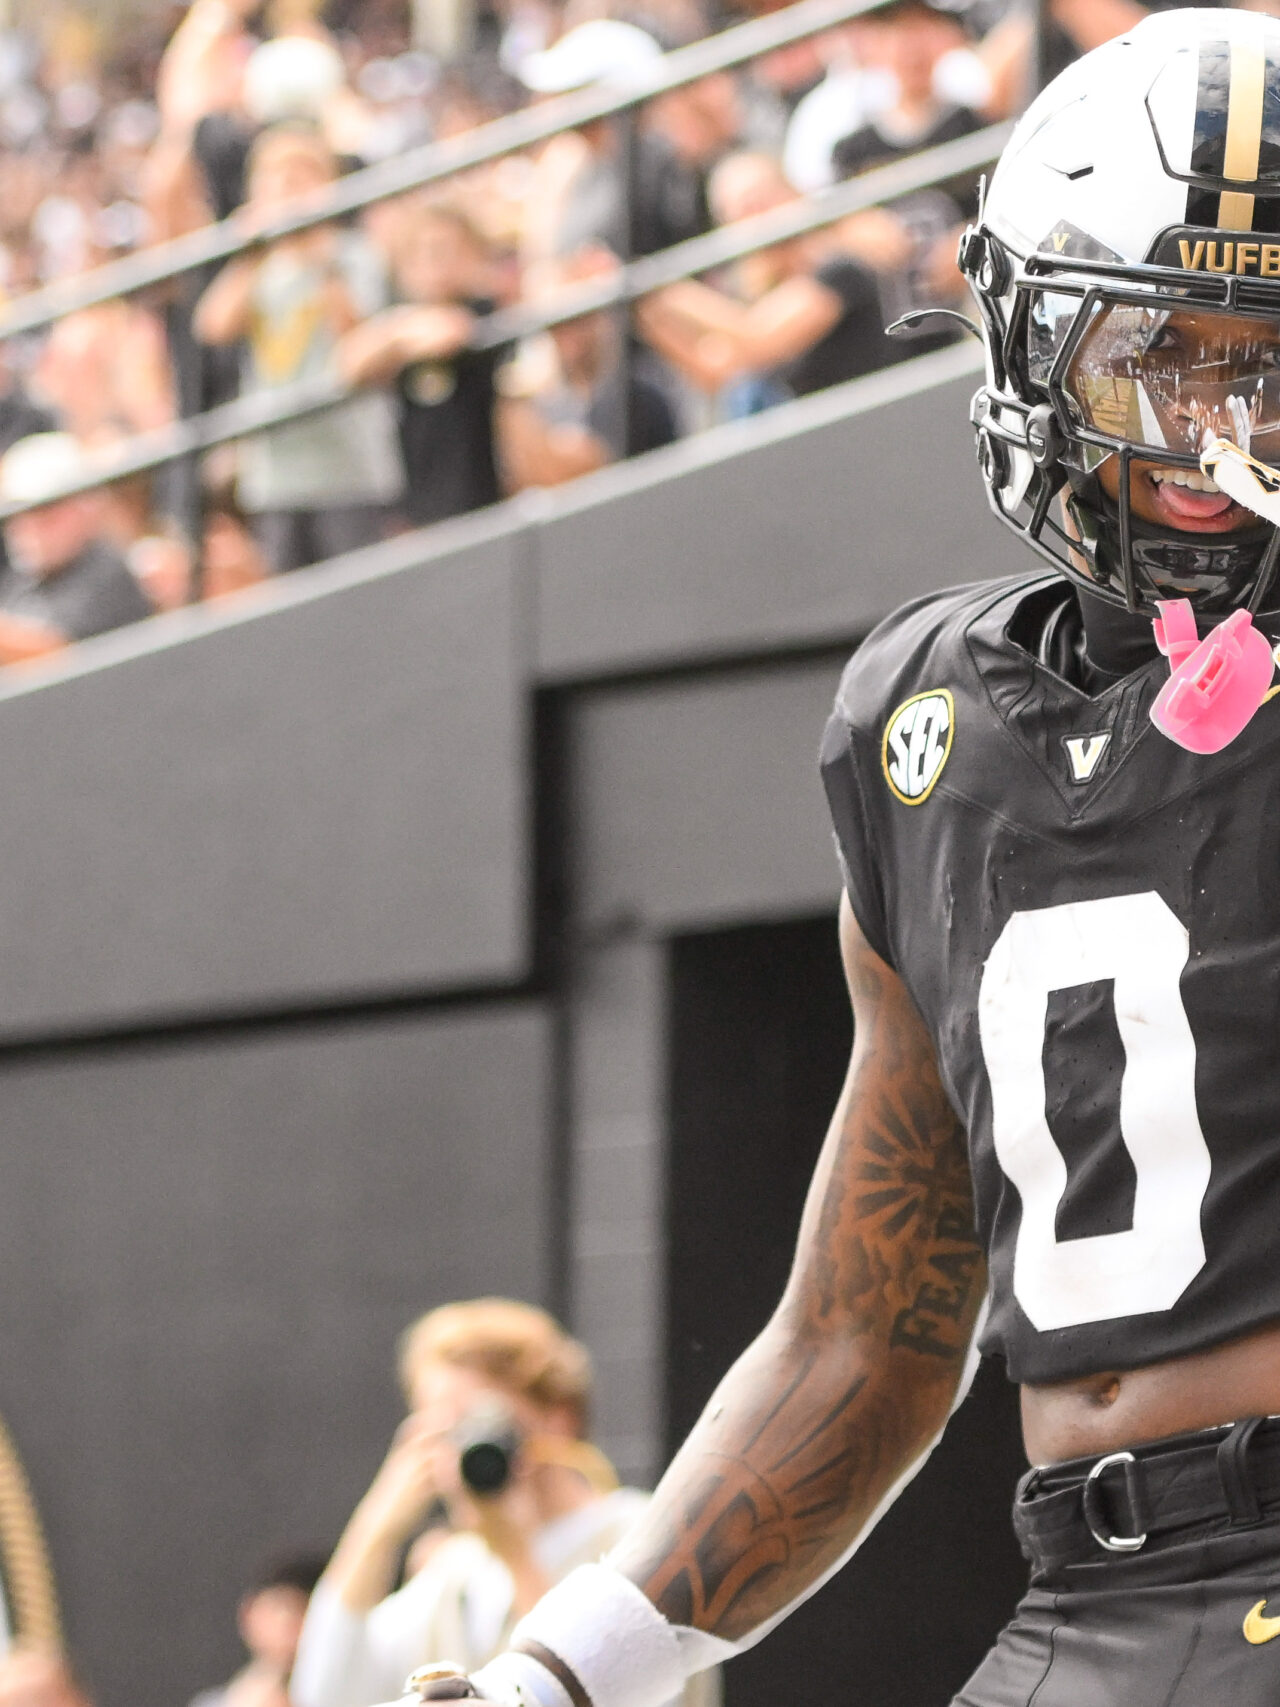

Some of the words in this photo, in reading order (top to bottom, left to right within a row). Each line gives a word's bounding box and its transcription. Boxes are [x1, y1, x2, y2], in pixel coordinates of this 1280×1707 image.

[1052, 232, 1071, 252] V
[888, 696, 950, 798] SEC
[1062, 731, 1111, 784] V
[978, 890, 1212, 1332] 0
